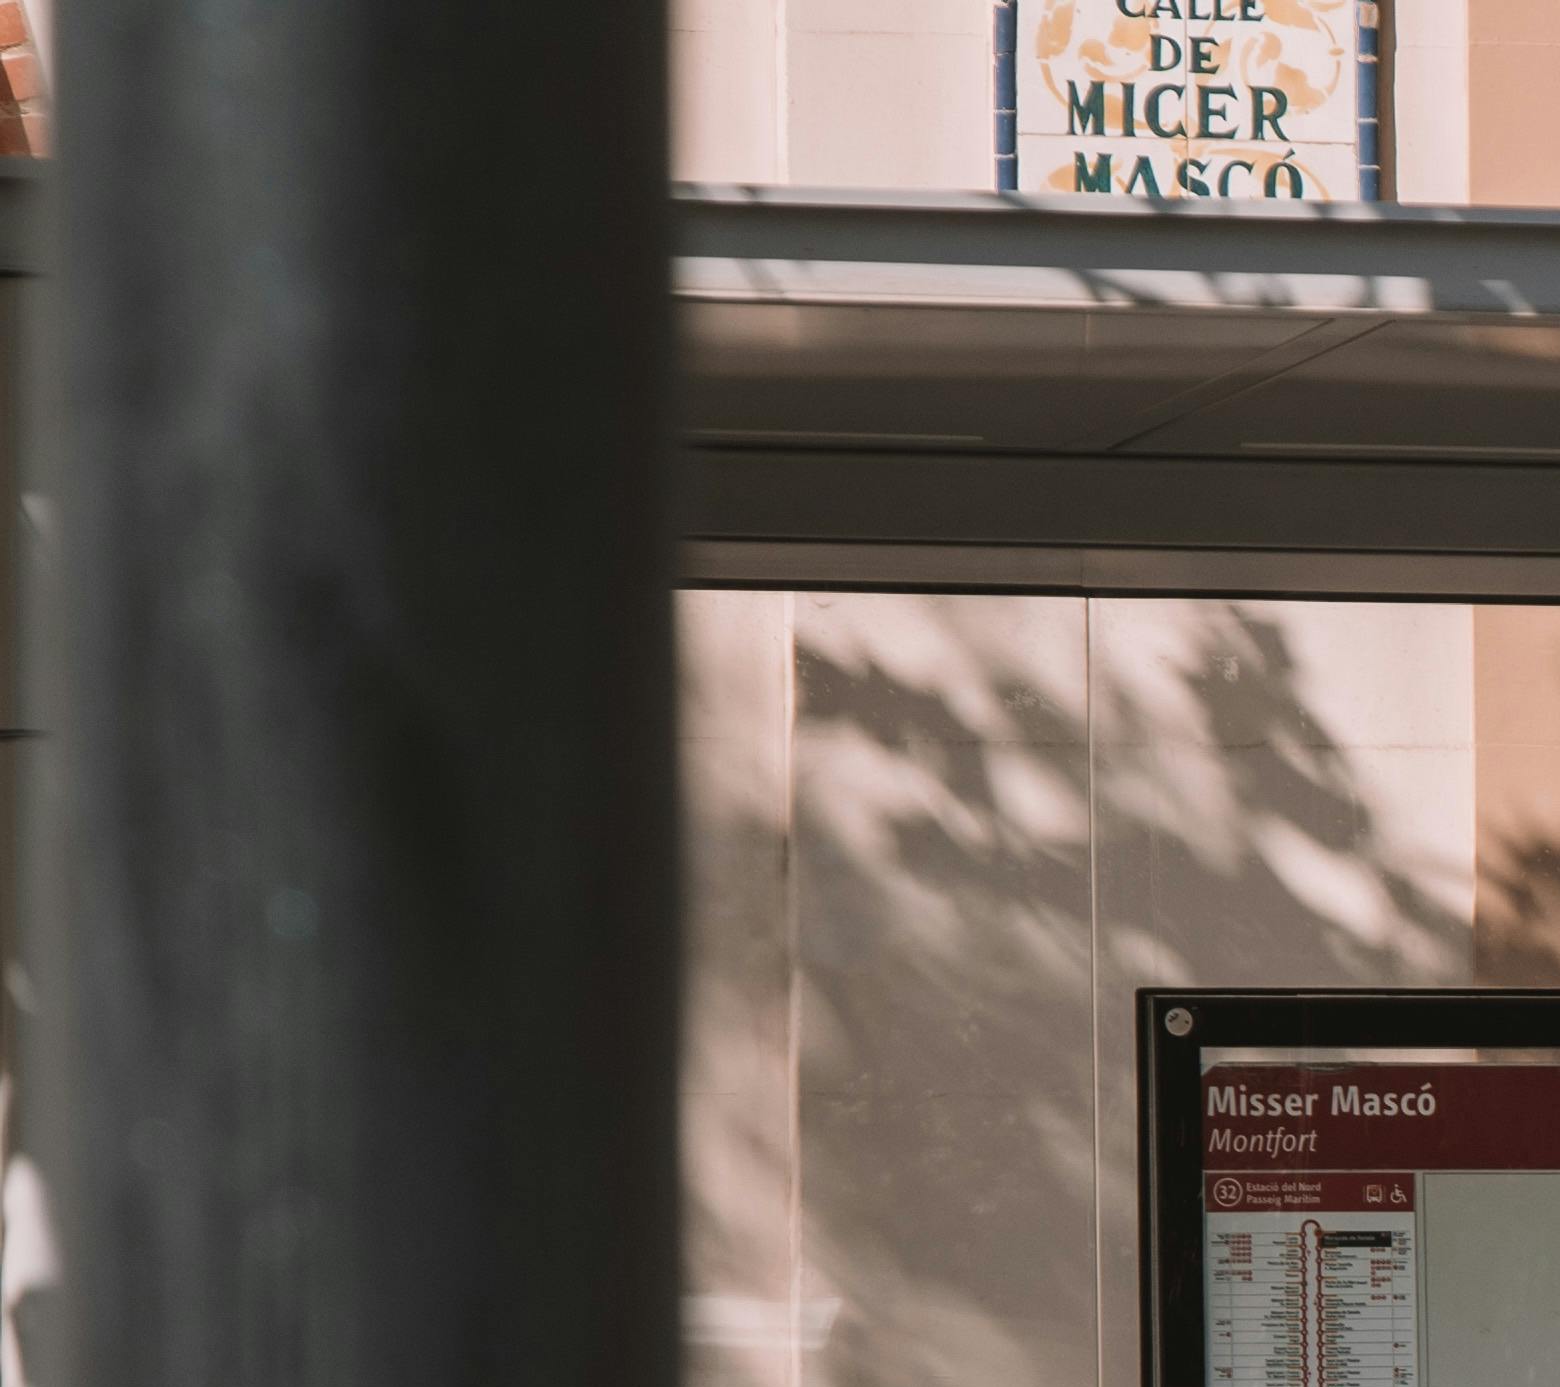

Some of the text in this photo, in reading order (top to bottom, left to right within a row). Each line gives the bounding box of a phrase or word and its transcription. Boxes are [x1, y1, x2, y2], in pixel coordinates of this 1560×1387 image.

[1149, 34, 1220, 74] DE
[1066, 79, 1290, 141] MICER
[1074, 148, 1304, 200] MASCÓ
[1207, 1082, 1436, 1117] Misser Mascó
[1208, 1126, 1319, 1159] Montfort
[1218, 1185, 1238, 1200] 32
[1282, 1182, 1296, 1192] del
[1299, 1182, 1322, 1192] Nord
